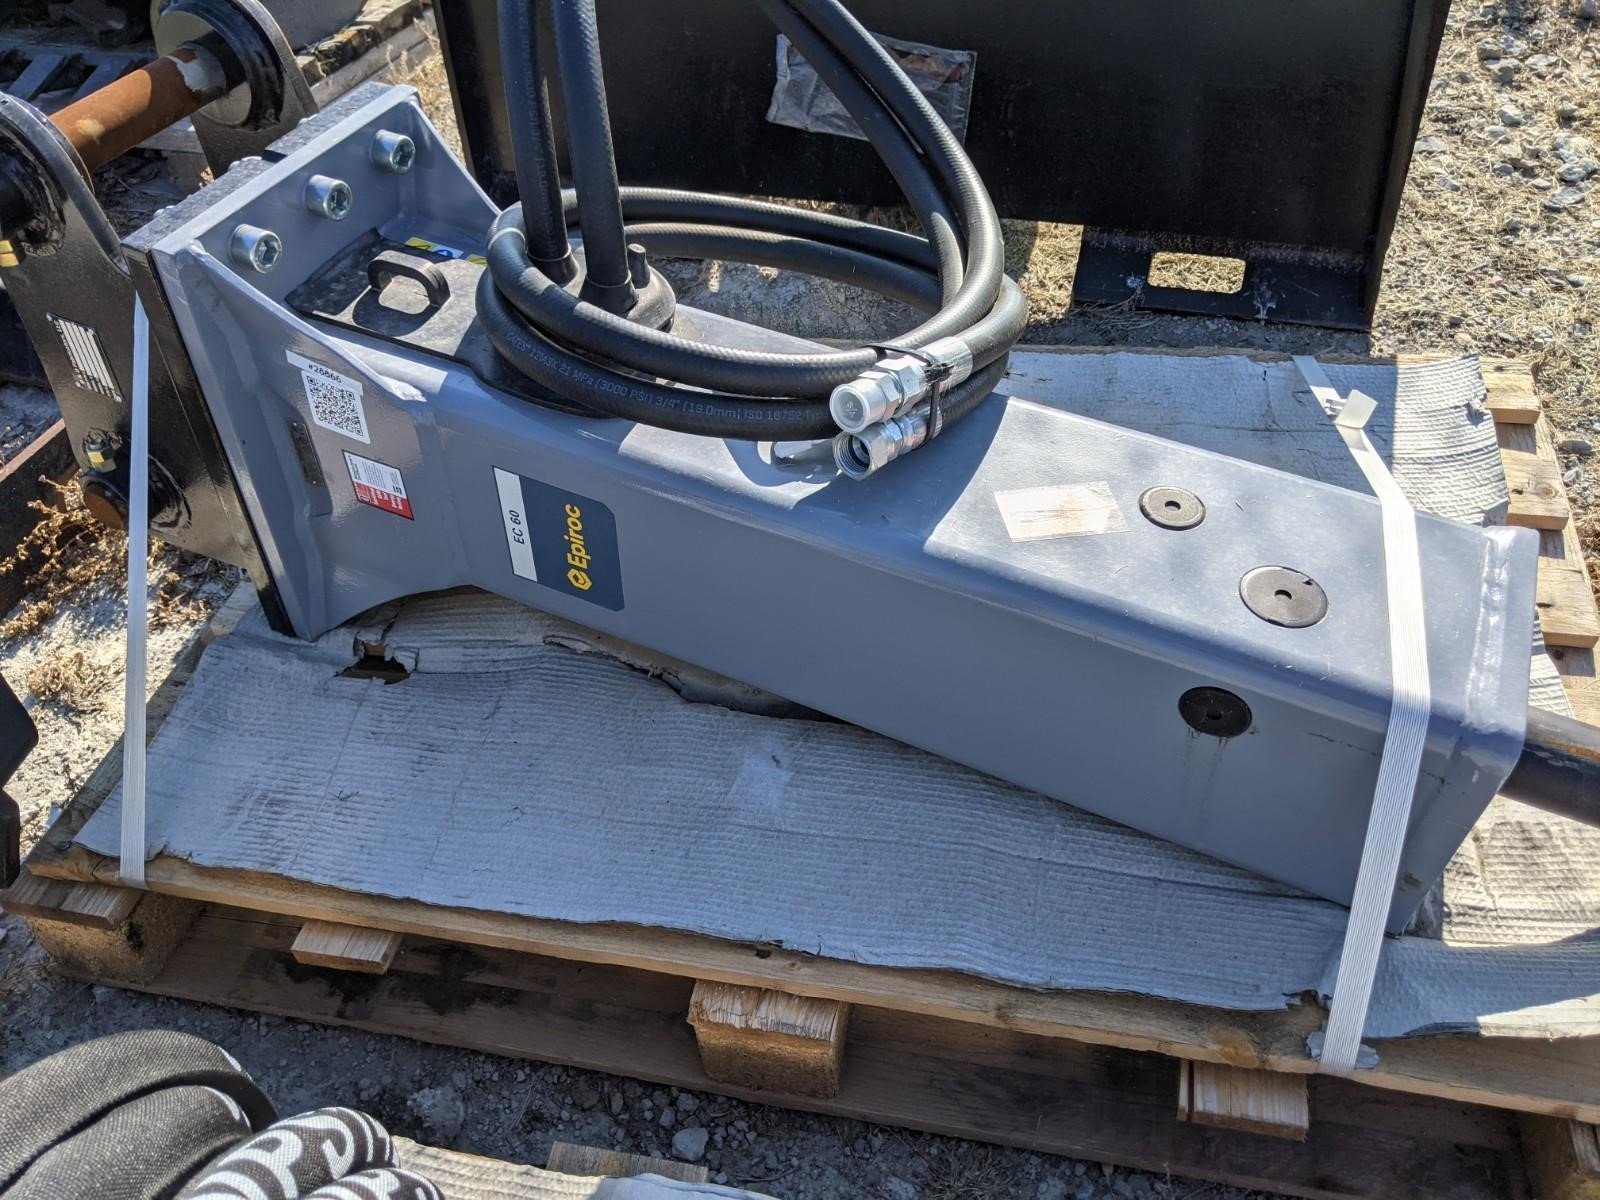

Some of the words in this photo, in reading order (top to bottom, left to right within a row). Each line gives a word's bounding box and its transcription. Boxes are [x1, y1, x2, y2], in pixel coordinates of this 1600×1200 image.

[309, 363, 342, 384] #28866
[570, 369, 595, 385] MPa
[743, 408, 763, 420] ISO
[509, 510, 521, 525] 60
[512, 528, 525, 545] EC
[563, 504, 591, 569] Epiroc
